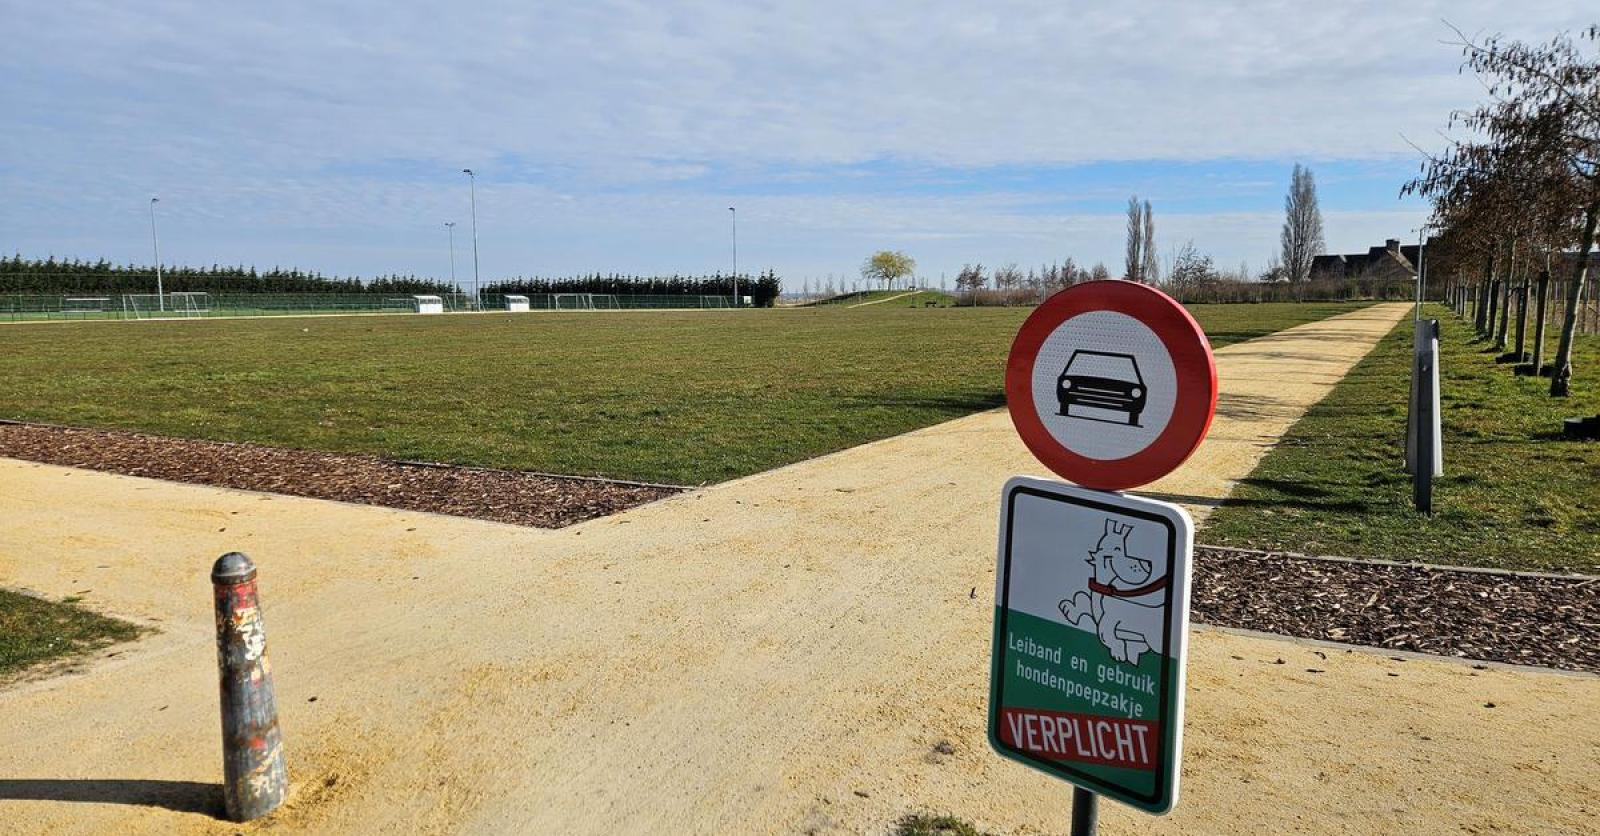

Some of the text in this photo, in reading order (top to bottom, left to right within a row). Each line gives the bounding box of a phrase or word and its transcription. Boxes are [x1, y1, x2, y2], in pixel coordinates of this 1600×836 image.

[1009, 632, 1155, 695] Leiband en gebruik
[1016, 660, 1143, 719] hondenpoepzakje
[1007, 713, 1148, 764] VERPLICHT
